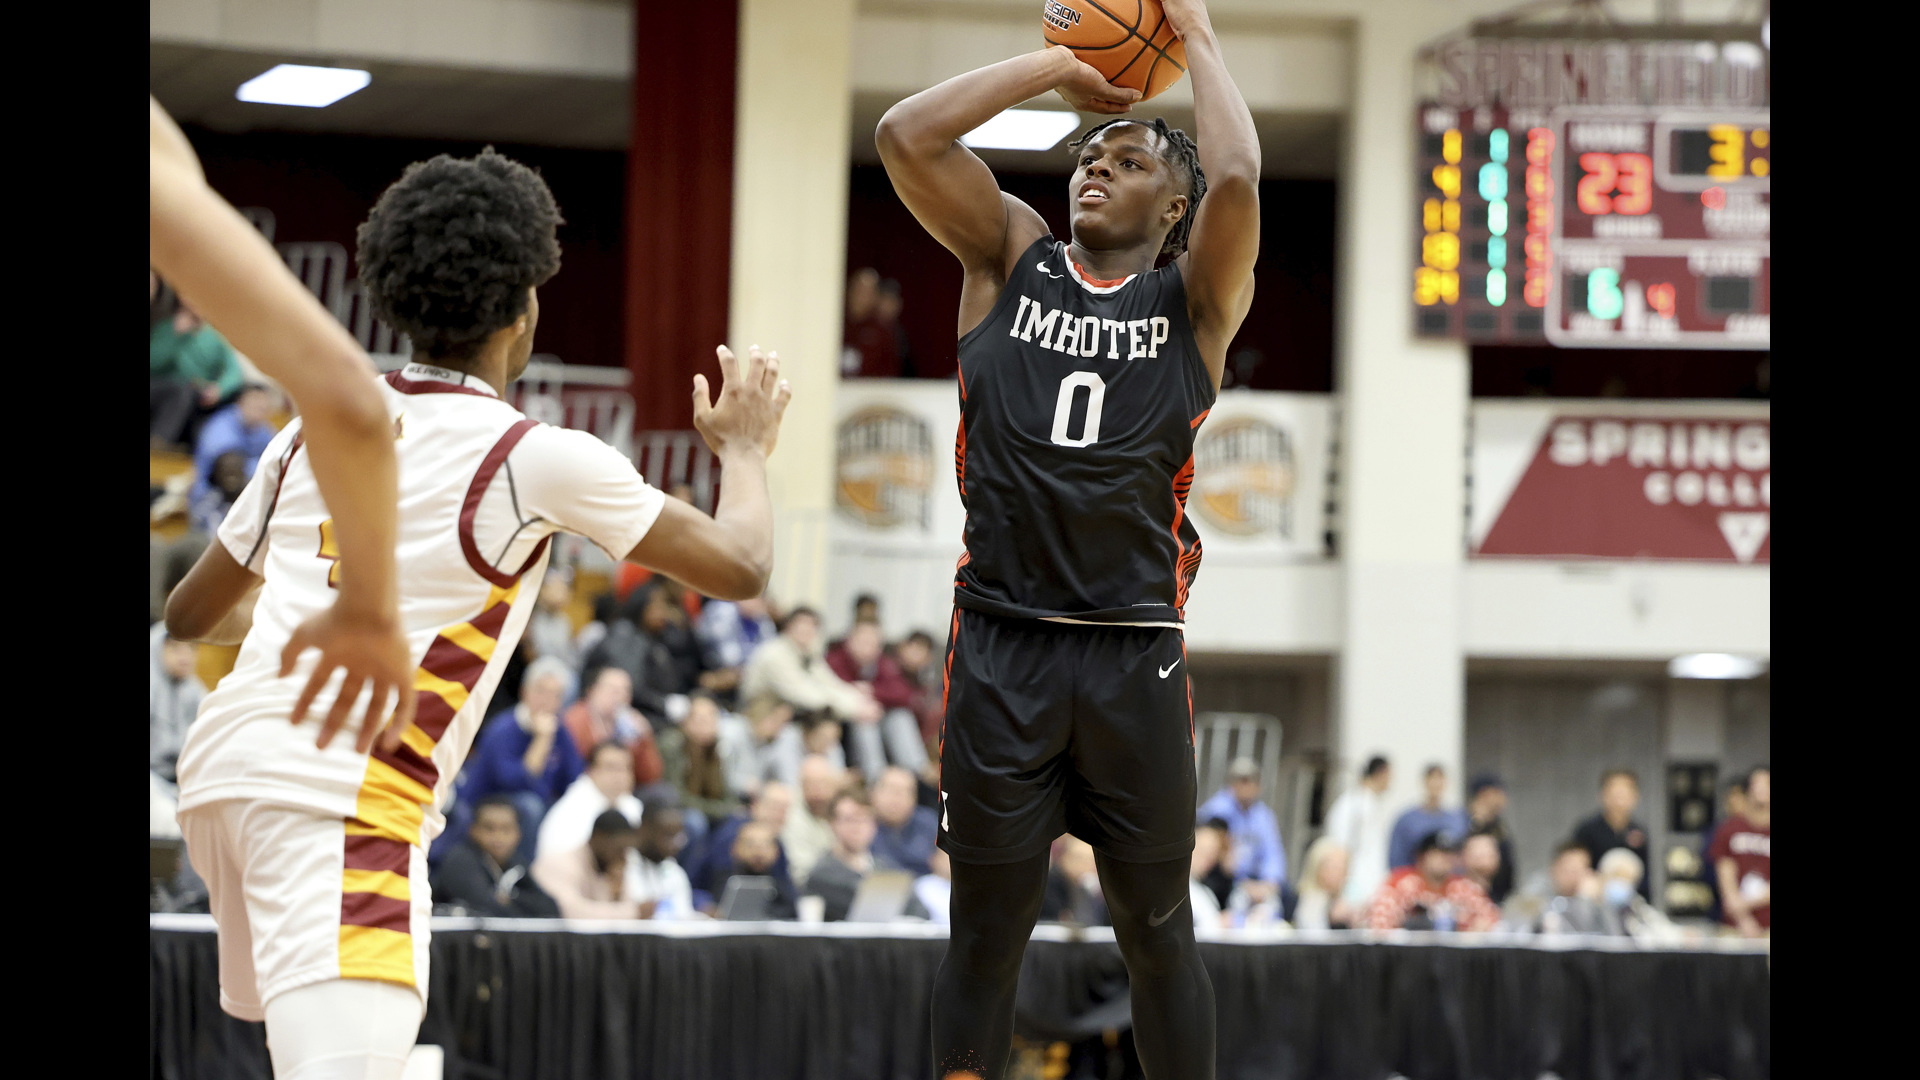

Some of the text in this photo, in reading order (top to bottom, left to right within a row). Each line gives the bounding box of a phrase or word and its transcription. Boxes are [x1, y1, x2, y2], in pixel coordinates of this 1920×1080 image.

[1577, 152, 1653, 215] 23
[1009, 294, 1170, 361] IMHOTEP
[1050, 370, 1107, 448] 0
[1550, 420, 1770, 471] SPRING
